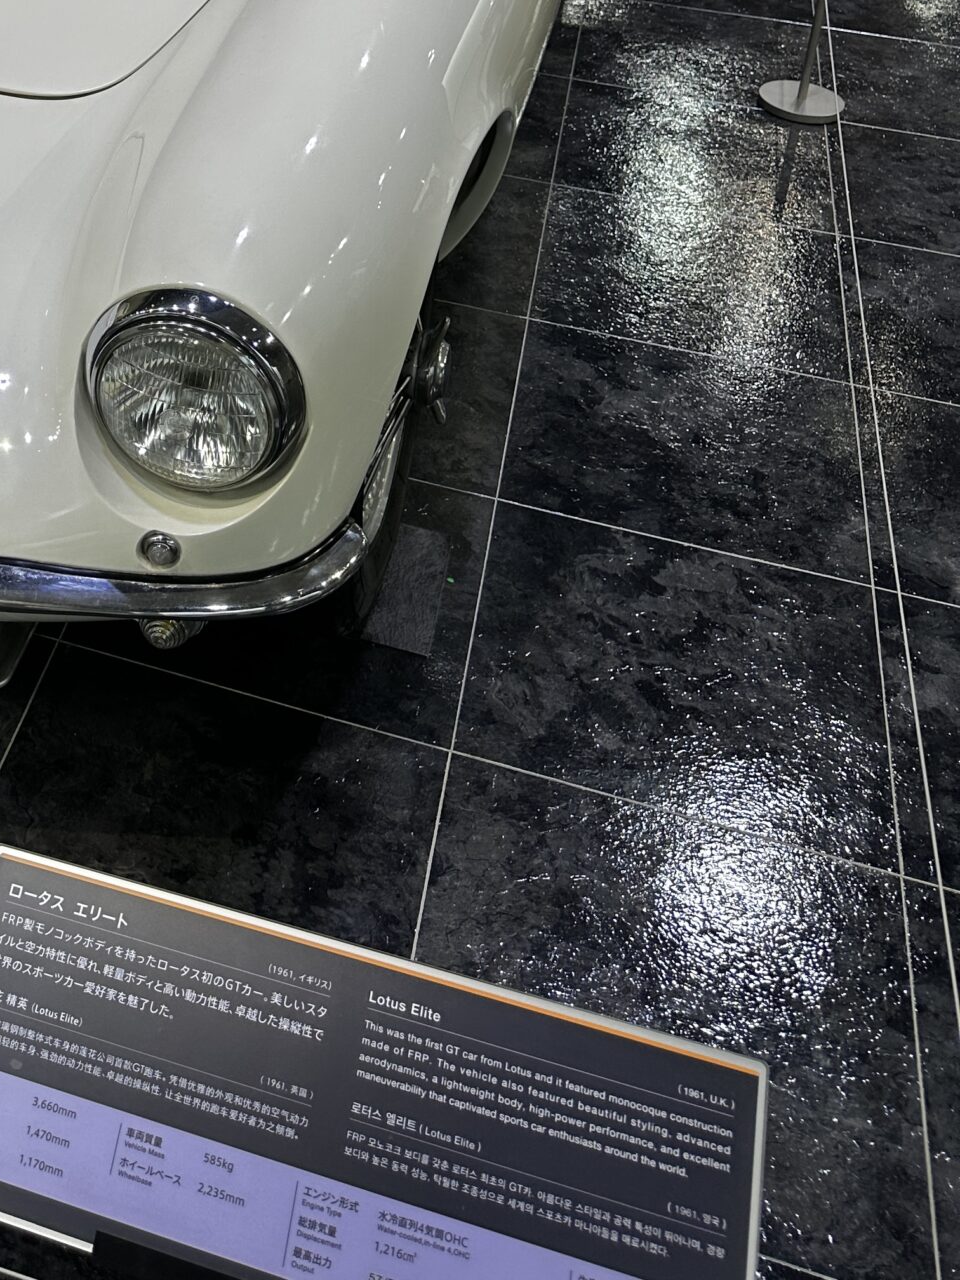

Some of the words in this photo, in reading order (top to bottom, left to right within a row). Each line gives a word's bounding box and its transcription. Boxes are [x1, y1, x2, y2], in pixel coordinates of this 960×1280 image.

[8, 883, 65, 912] ロータス
[73, 902, 128, 929] エリート
[268, 963, 296, 981] (1961,
[298, 974, 332, 991] イギリス)
[368, 990, 407, 1012] Lotus
[410, 1002, 441, 1023] Elite
[361, 1037, 390, 1052] made
[393, 1047, 405, 1056] of
[407, 1048, 432, 1065] FRP.
[436, 1057, 456, 1072] The
[459, 1066, 498, 1085] vehicle
[501, 1079, 524, 1093] also
[527, 1085, 574, 1108] featured
[577, 1100, 627, 1124] beautiful
[630, 1118, 672, 1139] styling,
[675, 1132, 731, 1156] advanced
[364, 1019, 384, 1034] This
[386, 1028, 405, 1040] was
[407, 1033, 423, 1045] the
[424, 1037, 444, 1052] first
[445, 1044, 461, 1056] GT
[462, 1050, 478, 1062] car
[480, 1054, 503, 1069] from
[504, 1061, 532, 1078] Lotus
[534, 1072, 554, 1085] and
[555, 1077, 563, 1088] it
[565, 1079, 606, 1101] featured
[608, 1094, 668, 1119] monocoque
[669, 1113, 733, 1138] construction
[31, 1096, 77, 1120] 3,660mm
[350, 1101, 382, 1121] 로터스
[385, 1112, 417, 1132] 엘리트
[356, 1069, 427, 1099] maneuverability
[428, 1090, 447, 1104] that
[448, 1097, 498, 1119] captivated
[498, 1113, 529, 1129] sports
[530, 1122, 547, 1134] car
[547, 1128, 603, 1152] enthusiasts
[603, 1145, 639, 1163] around
[640, 1155, 657, 1168] the
[658, 1161, 689, 1178] world.
[358, 1053, 429, 1082] aerodynamics,
[431, 1075, 438, 1084] a
[440, 1076, 495, 1101] lightweight
[497, 1093, 526, 1112] body,
[528, 1103, 587, 1129] high-power
[588, 1123, 657, 1152] performance,
[660, 1145, 680, 1157] and
[682, 1151, 731, 1173] excellent
[26, 1125, 71, 1149] 1,470mm
[125, 1127, 163, 1149] 車両質量
[203, 1152, 235, 1174] 585kg
[346, 1130, 366, 1143] FRP
[451, 1164, 478, 1180] 로터스
[19, 1153, 64, 1178] 1,170mm
[119, 1157, 182, 1187] ホイールベース
[197, 1182, 245, 1208] 2,235mm
[303, 1186, 360, 1214] エンジン形式
